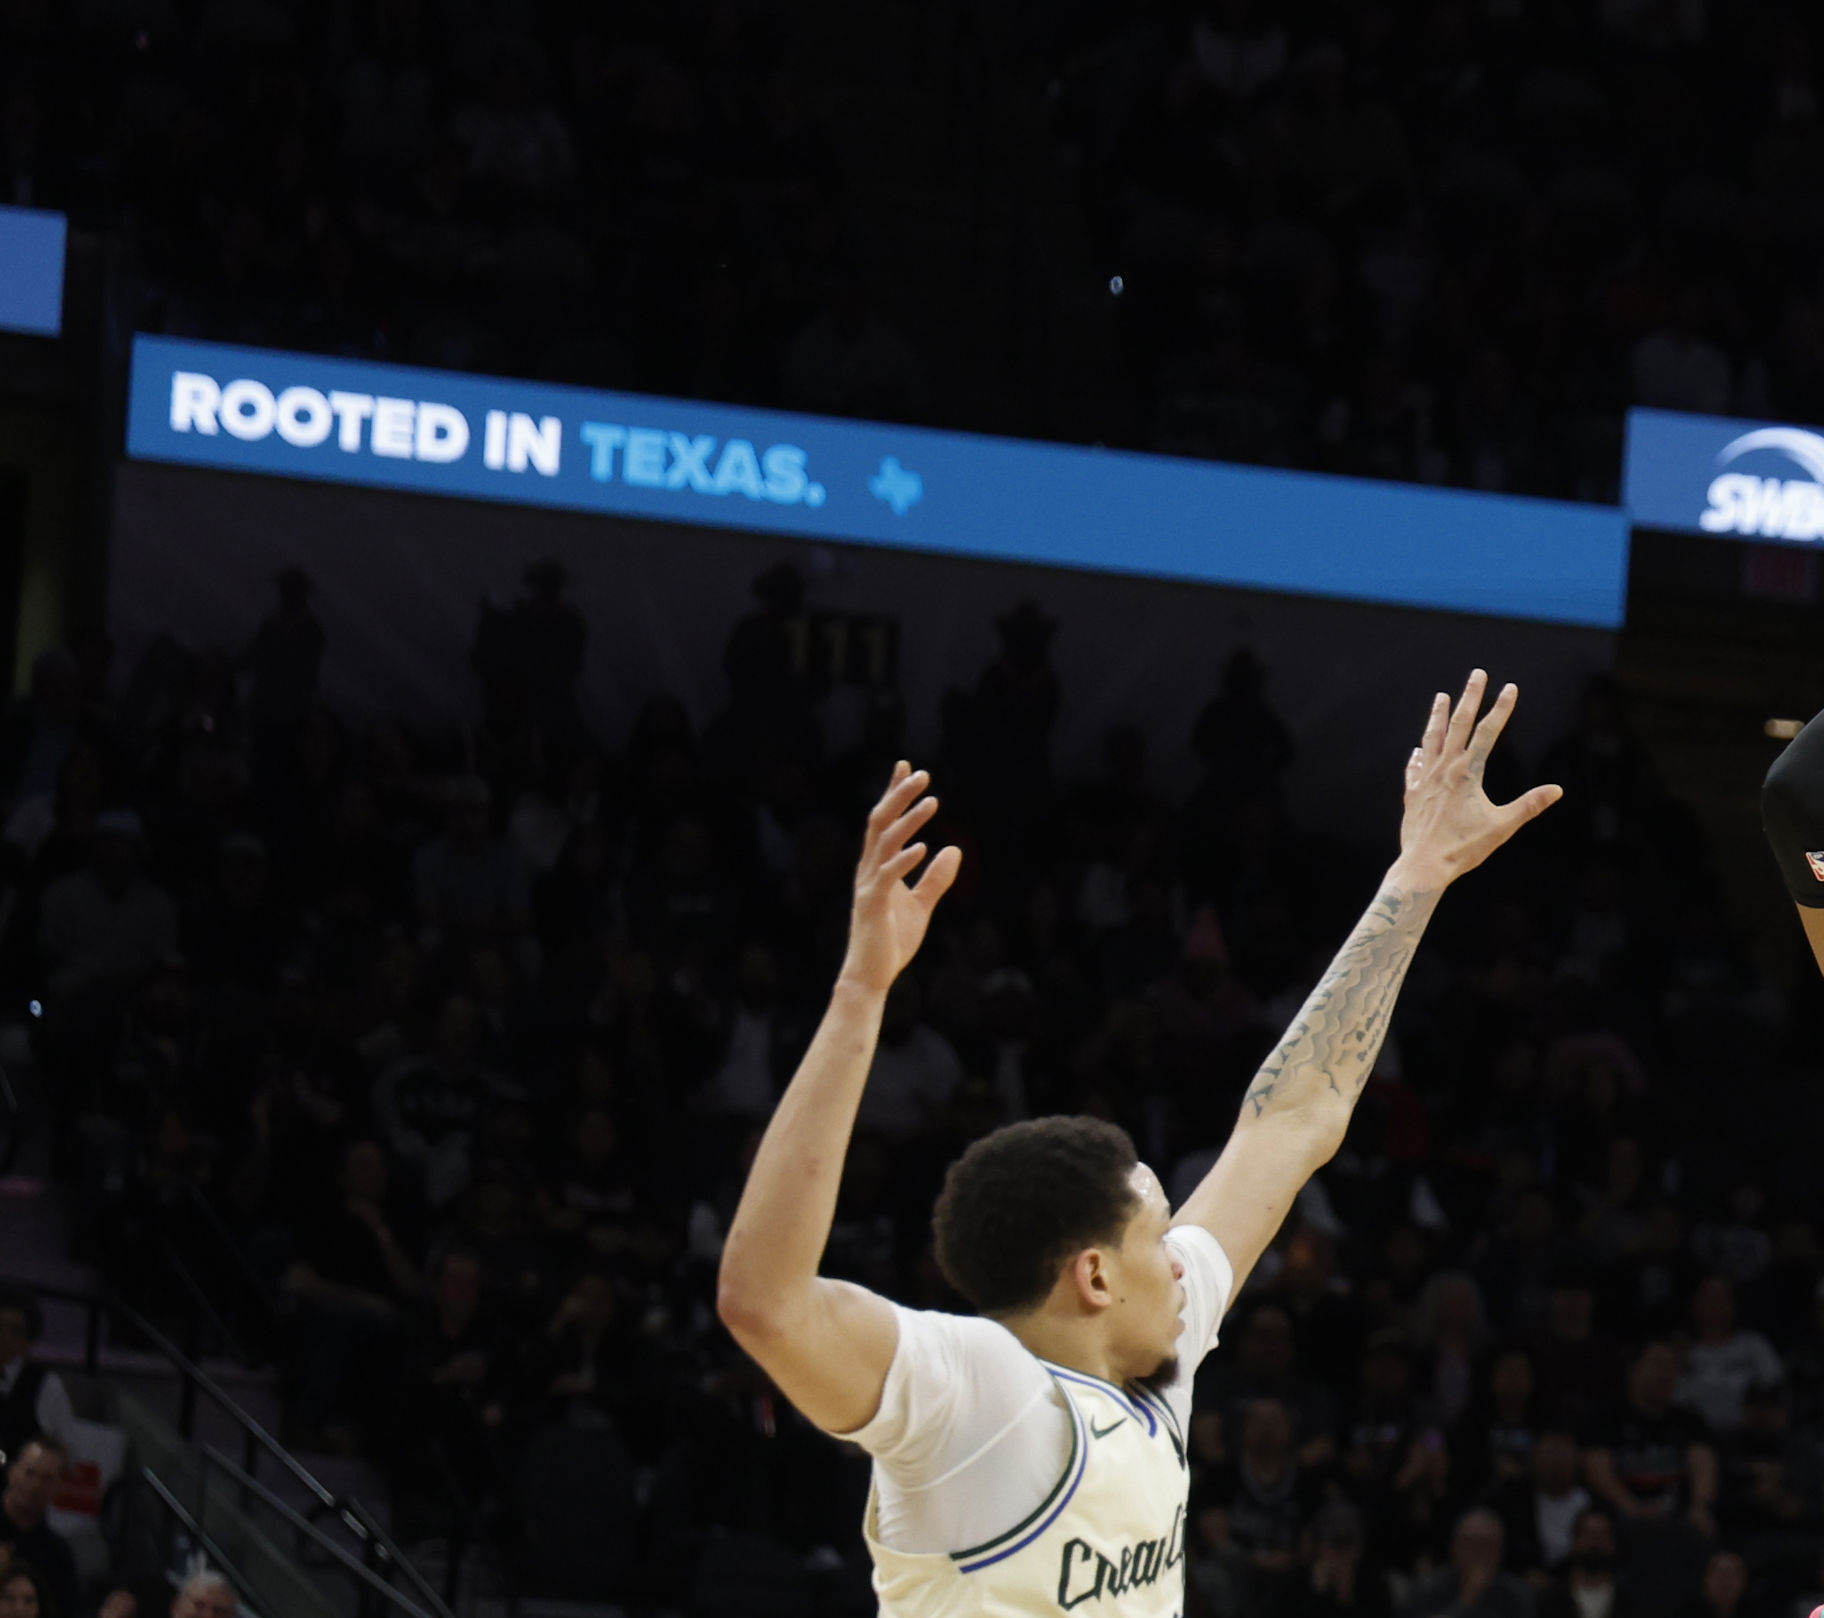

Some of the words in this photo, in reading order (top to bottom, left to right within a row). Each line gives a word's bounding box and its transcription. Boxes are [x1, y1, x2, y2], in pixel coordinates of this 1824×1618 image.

[169, 370, 470, 464] ROOTED
[483, 409, 563, 477] IN
[579, 421, 826, 507] TEXAS.
